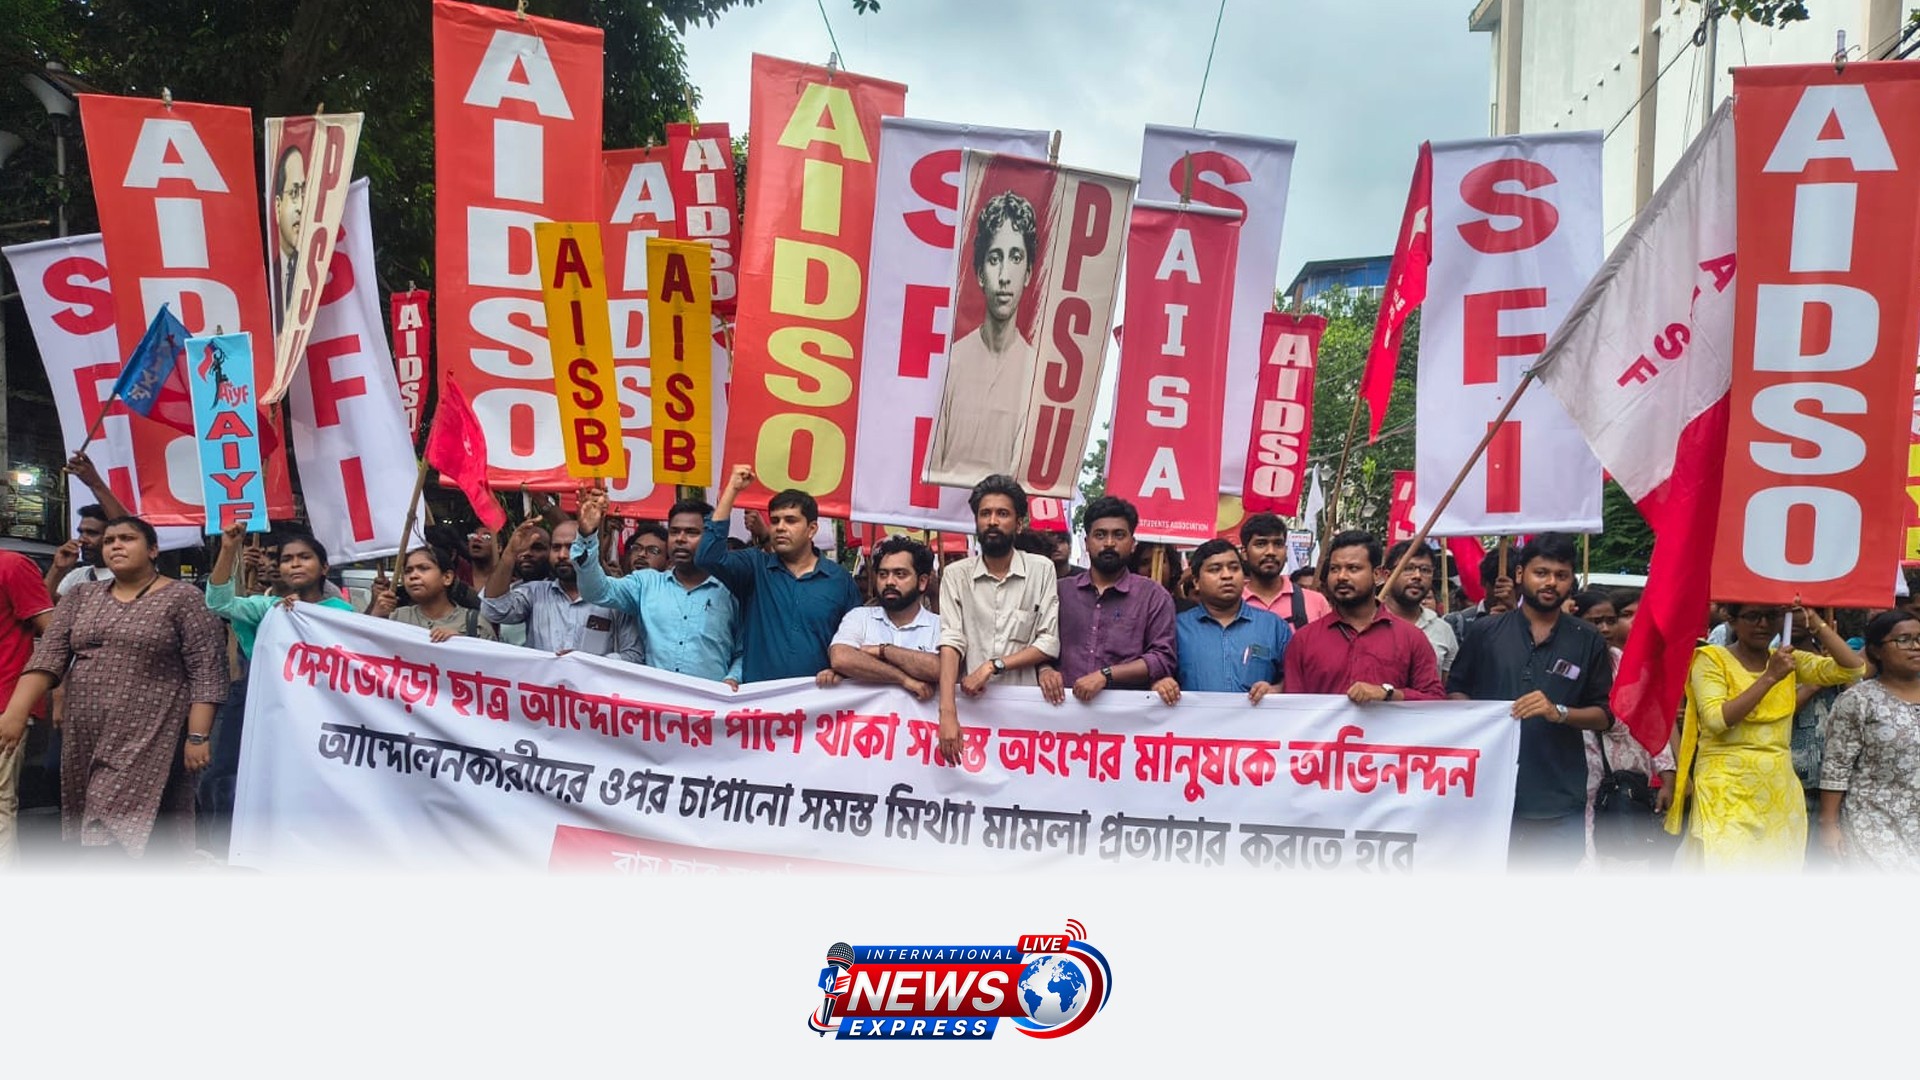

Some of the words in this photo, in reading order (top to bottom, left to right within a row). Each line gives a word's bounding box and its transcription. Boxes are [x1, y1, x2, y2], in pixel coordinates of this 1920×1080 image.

[463, 29, 574, 471] AIDSO
[553, 237, 610, 465] AISB
[660, 253, 697, 473] AISB
[755, 82, 872, 497] AIDSO
[1027, 181, 1113, 491] PSU
[1457, 158, 1560, 514] SFI
[1616, 253, 1737, 387] ASF
[1743, 84, 1898, 582] AIDSO
[205, 410, 257, 531] AIYF
[1138, 229, 1201, 500] AISA
[1252, 333, 1313, 497] AIDSO
[283, 641, 440, 714] দেশজোড়া
[447, 671, 512, 722] ছাত্র
[518, 682, 715, 748] আন্দোলনের
[725, 708, 807, 754] পাশে
[816, 710, 900, 761] থাকা
[998, 728, 1126, 782] অংশের
[1134, 732, 1281, 802] মানুষকে
[1289, 725, 1480, 797] অভিনন্দন
[318, 722, 595, 804] আন্দোলনকারীদের
[600, 768, 675, 815] ওপর
[679, 775, 795, 827] চাপানো
[799, 788, 878, 837] সমস্ত
[885, 783, 975, 845] মিথ্যা
[982, 804, 1091, 856] মামলা
[1098, 811, 1231, 867] প্রত্যাহার
[1239, 823, 1345, 871] করতে
[1355, 830, 1418, 874] হবে
